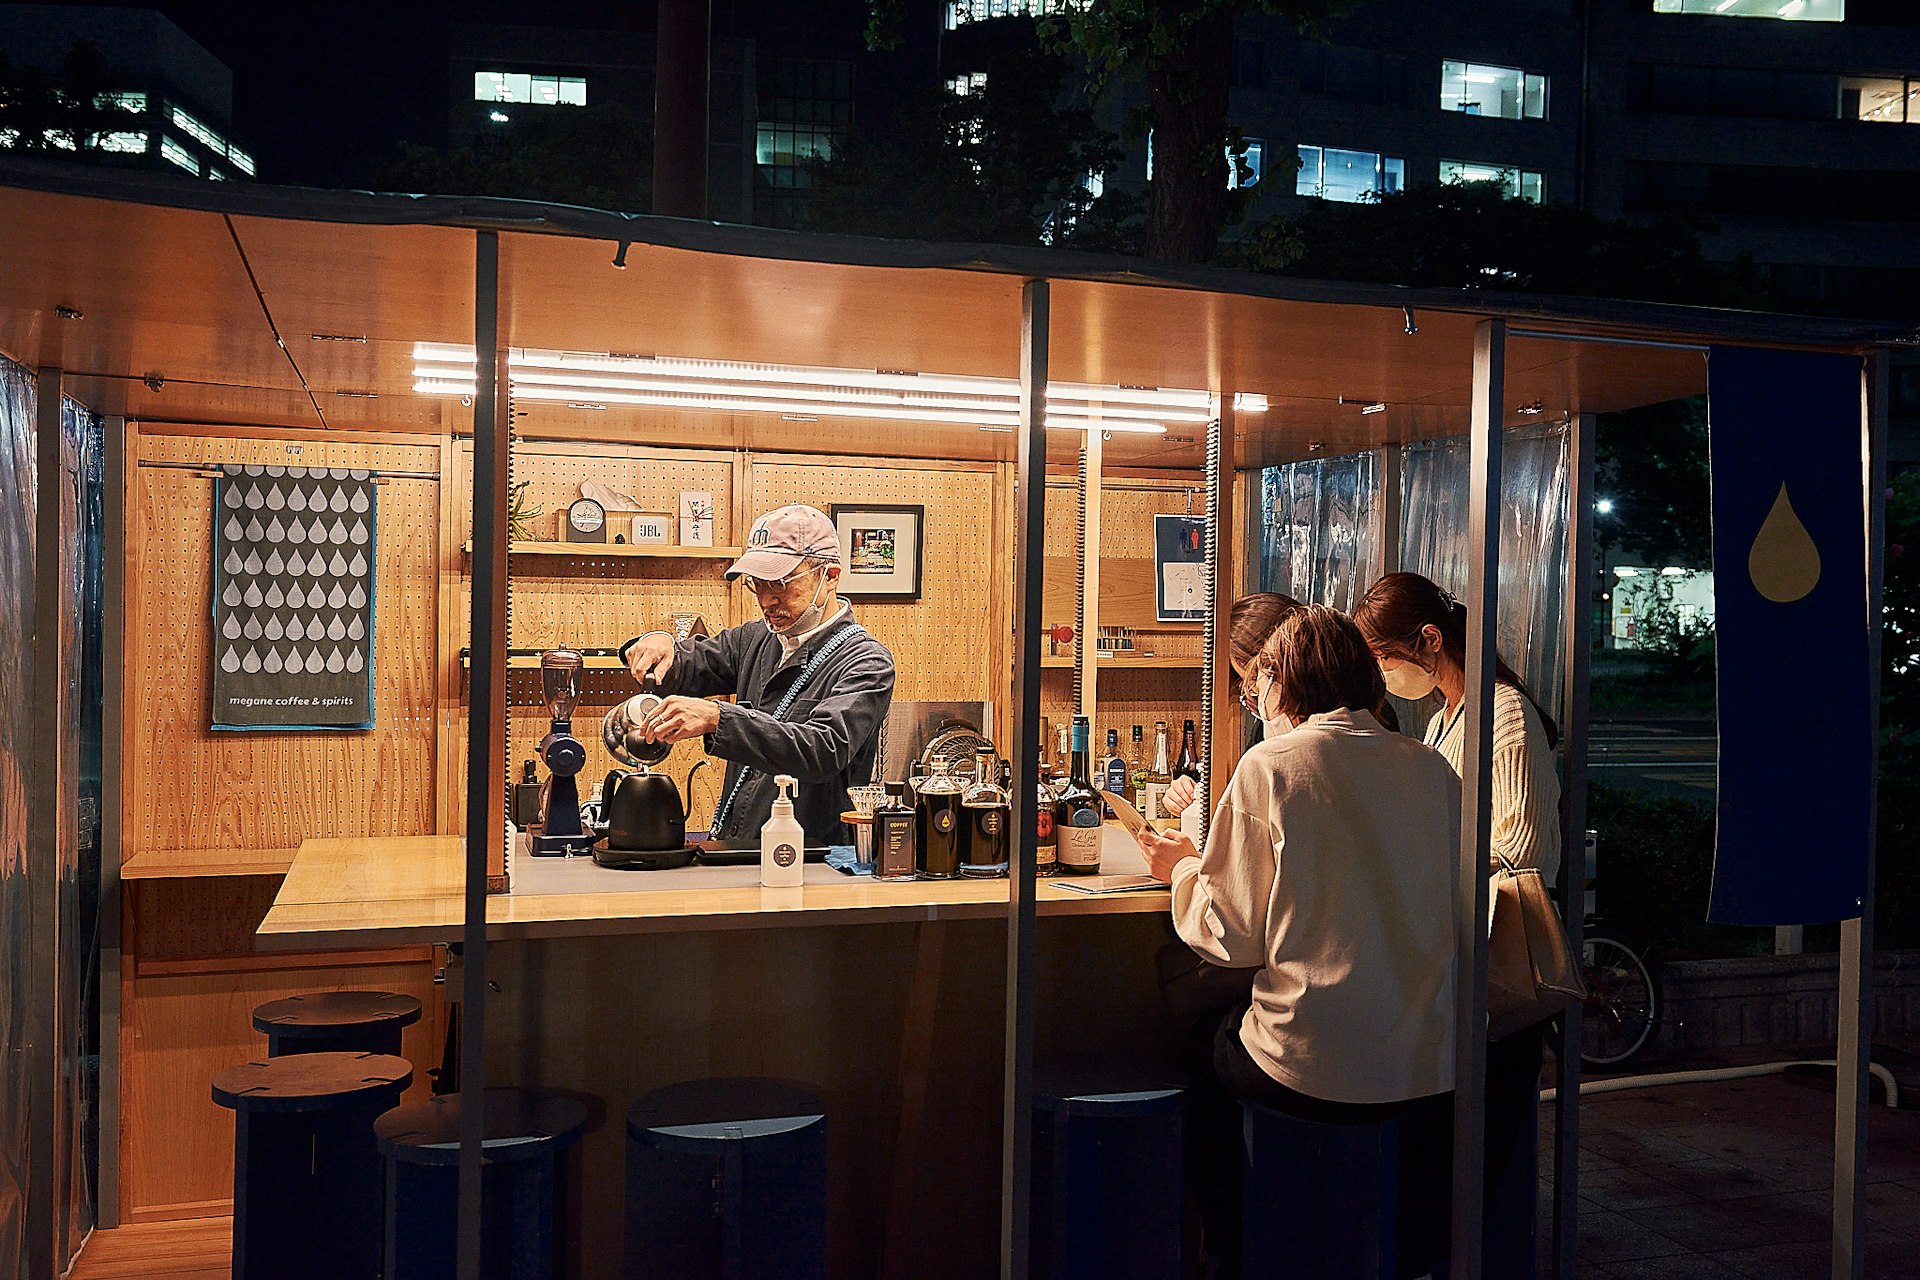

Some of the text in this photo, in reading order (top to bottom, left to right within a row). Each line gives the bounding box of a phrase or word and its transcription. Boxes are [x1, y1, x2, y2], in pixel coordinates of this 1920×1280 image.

[640, 524, 661, 537] JBL
[229, 696, 354, 707] megane coffee & spirits
